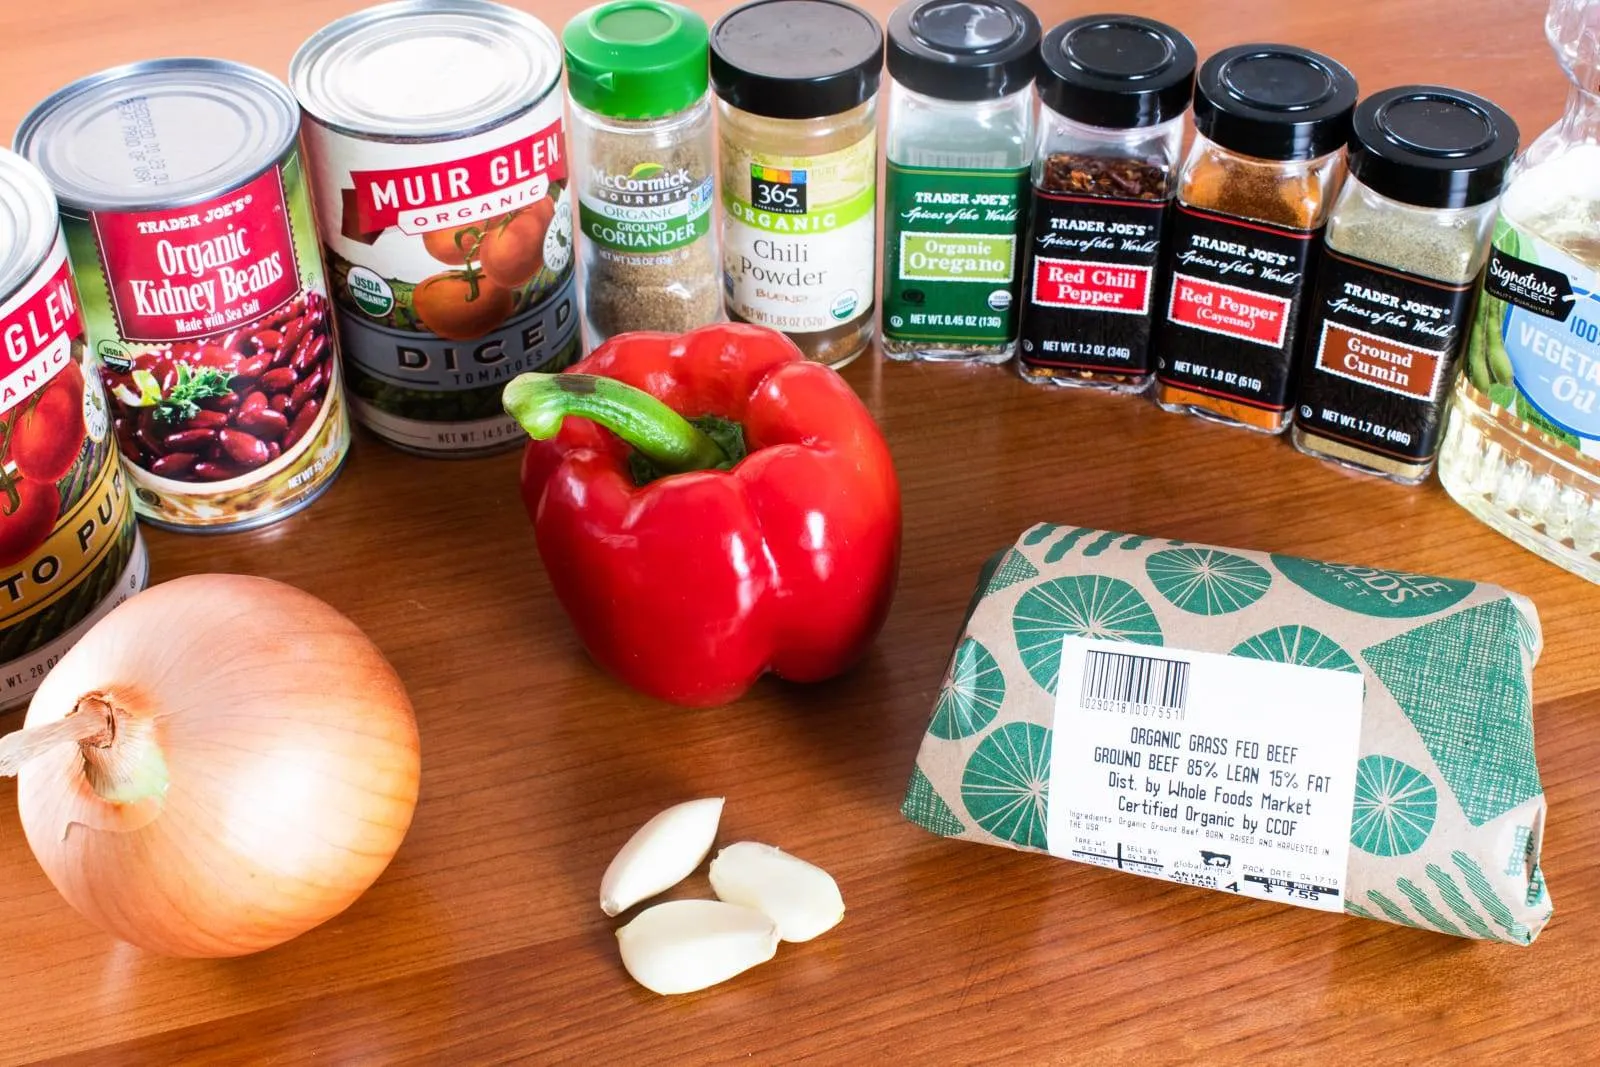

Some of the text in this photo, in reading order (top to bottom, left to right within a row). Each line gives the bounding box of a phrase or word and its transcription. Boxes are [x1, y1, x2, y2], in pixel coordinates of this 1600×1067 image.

[370, 133, 559, 211] MUIR GLEN
[592, 168, 692, 191] McCormick
[414, 184, 540, 227] ORGANIC
[598, 189, 684, 204] GOURMET
[758, 183, 799, 208] 365
[915, 192, 969, 204] TRADER
[137, 214, 200, 234] TRADER
[603, 204, 678, 220] ORGANIC
[732, 202, 837, 231] ORGANIC
[901, 207, 1020, 224] Spices of the World
[592, 222, 696, 247] CORIANDER
[616, 222, 668, 233] GROUND
[1050, 218, 1105, 233] TRADER
[157, 224, 250, 277] Organic
[754, 240, 808, 263] Chili
[925, 240, 991, 256] Organic
[1036, 233, 1160, 252] Spices of the World
[1191, 234, 1246, 257] TRADER
[741, 256, 828, 287] Powder
[910, 252, 1005, 274] Oregano
[1176, 249, 1301, 285] Spices of the World
[129, 251, 283, 316] Kidney Beans
[354, 275, 382, 294] USDA
[1048, 266, 1137, 289] Red Chili
[1489, 258, 1558, 298] Signature
[1057, 284, 1124, 305] Pepper
[1179, 286, 1278, 322] Red Pepper
[1344, 282, 1399, 308] TRADER
[1508, 283, 1555, 305] SELECT
[4, 279, 75, 362] GLEN
[175, 299, 260, 333] Made with Sea Salt
[910, 313, 1002, 328] NET WT. 0.45 OZ (13G)
[1196, 307, 1256, 330] (Cayenne)
[1327, 298, 1456, 338] Spices of the World
[397, 299, 571, 371] DICED
[1570, 316, 1600, 346] 100
[1043, 340, 1130, 360] NET WT. 1.2 OZ (34G)
[1347, 337, 1412, 368] Ground
[1520, 321, 1600, 388] VEGETA
[2, 348, 63, 402] ANIC
[454, 350, 544, 386] TOMATOES
[1174, 360, 1262, 393] NET WT. 1.8 OZ (51G)
[1344, 353, 1409, 386] Cumin
[1552, 374, 1596, 414] Oil
[438, 432, 456, 443] NET
[1322, 409, 1411, 447] NET WT. 1.7 OZ (48G)
[0, 468, 122, 602] TO PUR
[6, 673, 27, 688] WT.
[30, 664, 44, 678] 28
[1131, 727, 1298, 764] ORGANIC GRASS FED BEEF
[1094, 746, 1331, 793] GROUND BEEF 85% LEAN 15% FAT
[1109, 771, 1311, 815] Dist. by Whole Foods Market
[1086, 823, 1100, 831] USA
[1118, 795, 1298, 836] Certified Organic by CCOF
[1118, 816, 1147, 828] Organic
[1150, 821, 1177, 833] Ground
[1205, 830, 1223, 840] BORN
[1230, 833, 1254, 845] RAISED
[1259, 838, 1273, 848] AND
[1277, 841, 1318, 855] HARVESTED
[1322, 848, 1330, 856] IN
[1242, 864, 1265, 874] PACK
[1270, 868, 1291, 878] DATE
[1225, 881, 1238, 892] 4
[1285, 887, 1319, 901] 7.55
